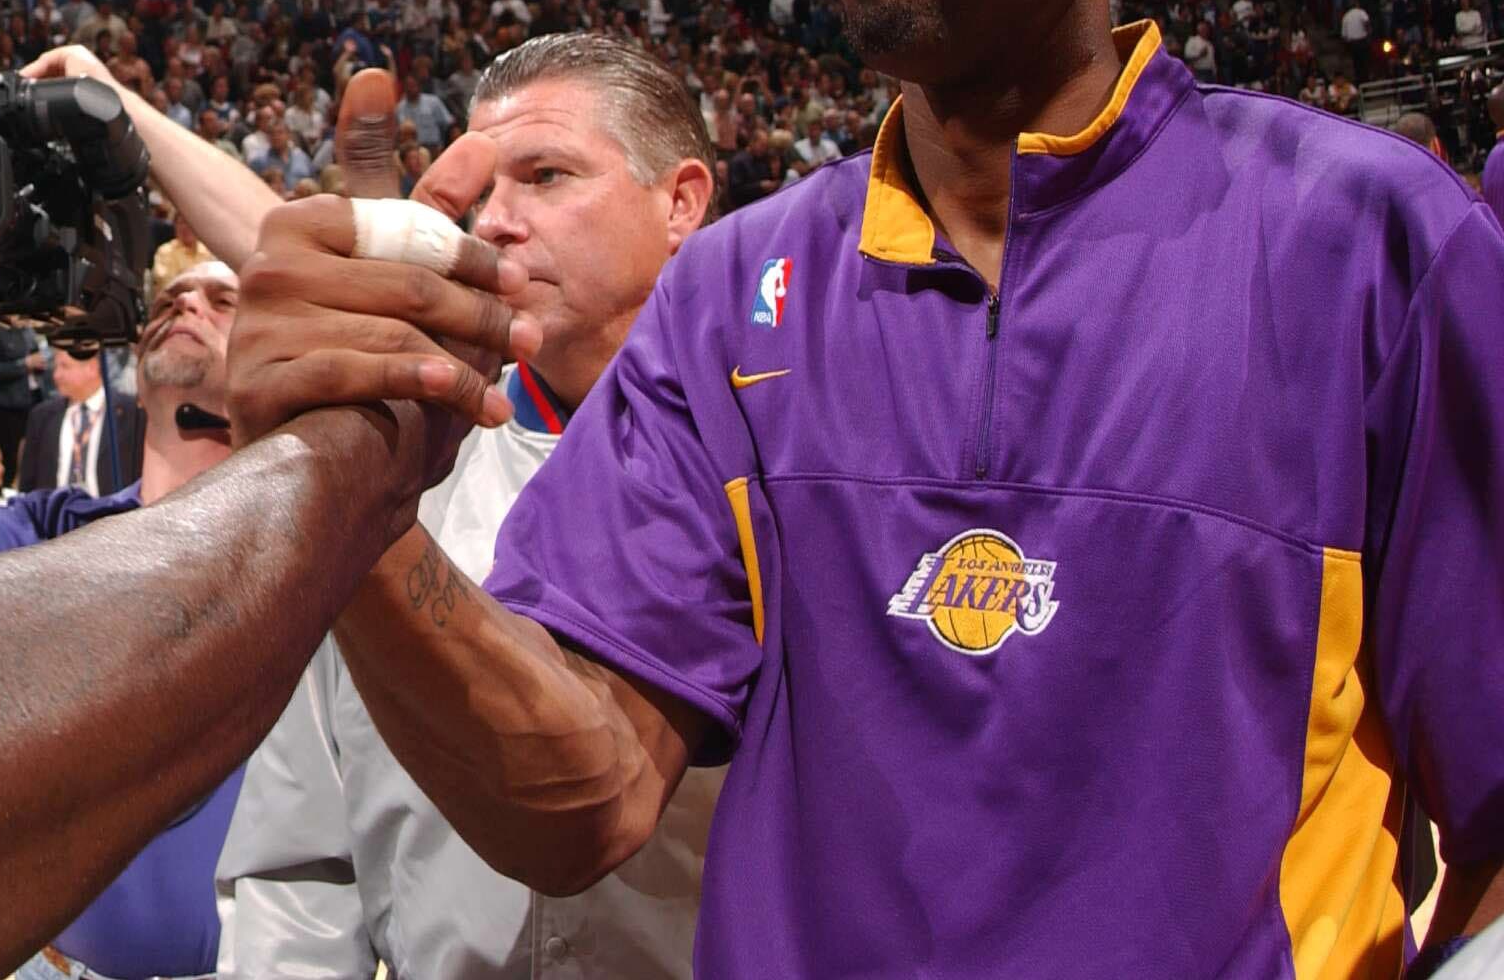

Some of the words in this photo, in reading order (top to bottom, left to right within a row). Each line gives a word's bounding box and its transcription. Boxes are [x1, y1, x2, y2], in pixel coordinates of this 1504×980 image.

[957, 557, 988, 570] LOS
[988, 559, 1053, 577] ANGELES
[897, 556, 1053, 631] LAKERS
